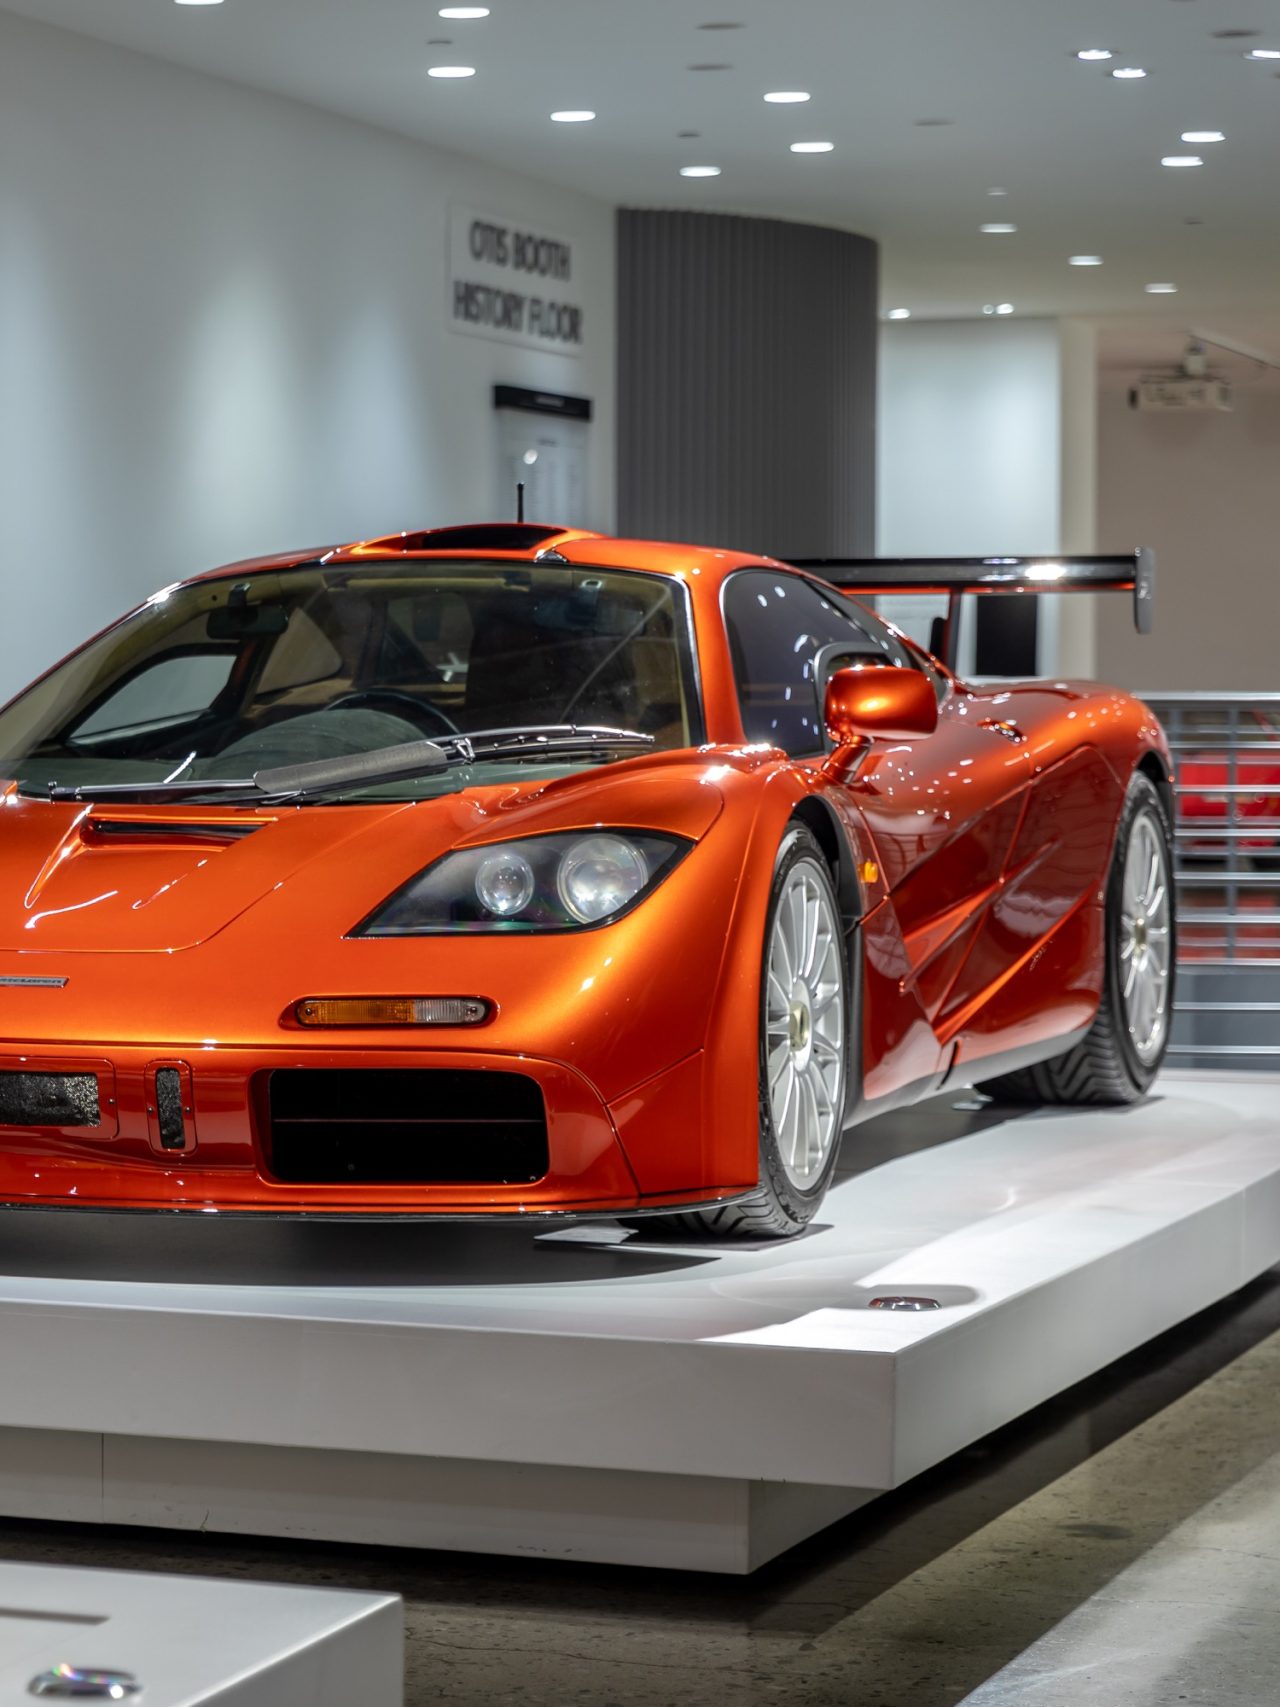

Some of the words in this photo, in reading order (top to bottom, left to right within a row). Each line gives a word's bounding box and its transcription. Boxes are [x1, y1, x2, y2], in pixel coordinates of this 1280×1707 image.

[470, 219, 508, 266] OTIS
[512, 231, 572, 282] BOOTH
[453, 279, 524, 332] HISTORY
[528, 297, 584, 344] FLOOR
